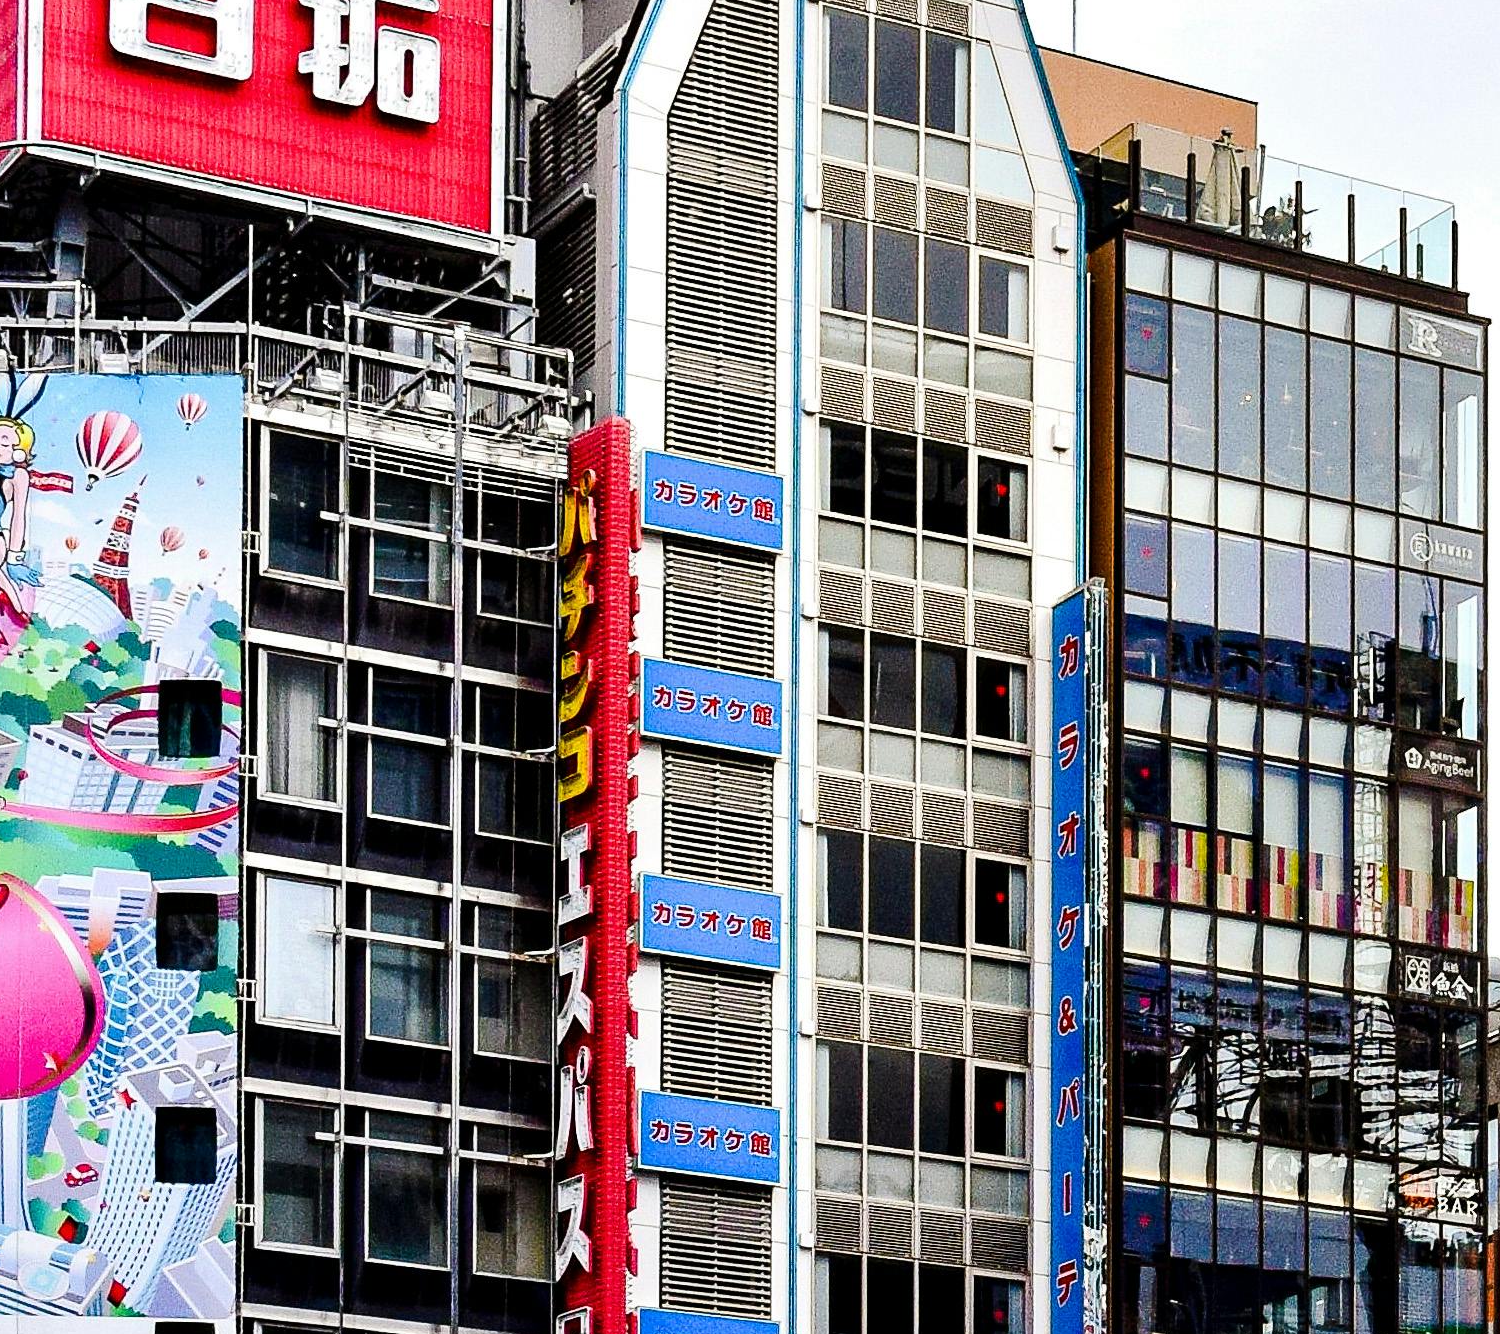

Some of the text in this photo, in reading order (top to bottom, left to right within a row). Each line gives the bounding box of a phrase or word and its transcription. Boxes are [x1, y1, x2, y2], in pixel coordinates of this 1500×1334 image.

[653, 479, 775, 523] カラオケ館
[558, 468, 598, 804] パチンコ
[653, 684, 774, 729] カラオケ館
[652, 901, 773, 944] カラオケ館
[555, 822, 594, 1284] エスパス
[649, 1120, 772, 1157] カラオケ館
[1437, 1198, 1478, 1216] BAR
